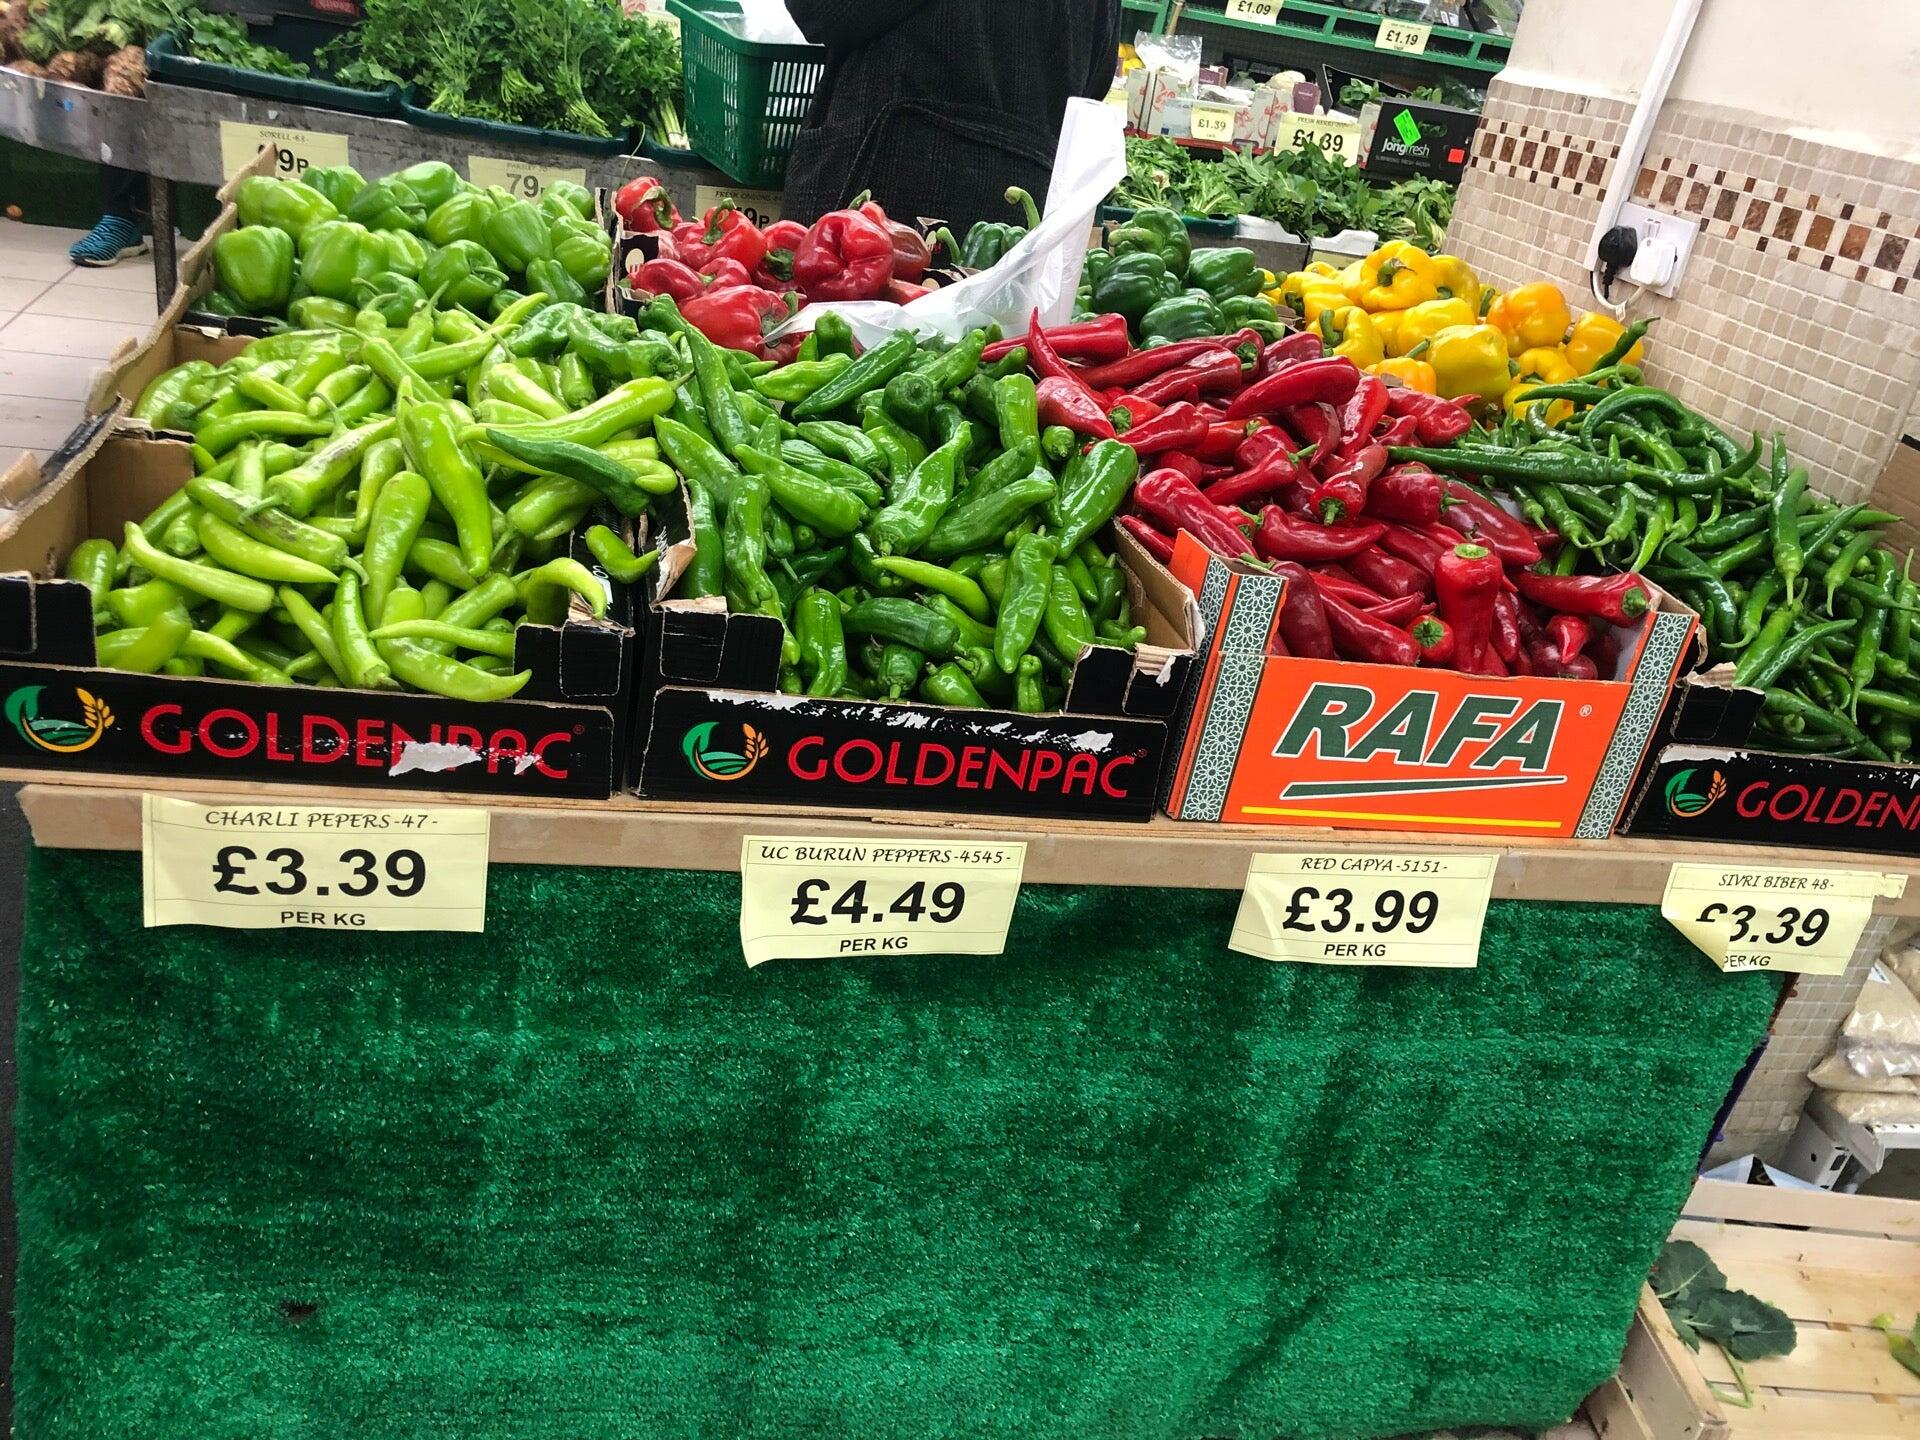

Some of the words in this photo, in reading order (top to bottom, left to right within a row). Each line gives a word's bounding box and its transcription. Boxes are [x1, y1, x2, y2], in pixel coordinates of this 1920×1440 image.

[1237, 0, 1271, 15] £1.09
[1385, 30, 1418, 45] £1.19
[1292, 129, 1343, 152] £139
[506, 172, 546, 198] 79
[736, 207, 770, 229] 9P
[1272, 682, 1566, 772] RAFA
[140, 703, 572, 779] GOLDENPAC
[787, 735, 1135, 798] GOLDENPAC
[205, 811, 298, 828] CHARLI
[761, 845, 789, 860] UC
[795, 846, 866, 861] BURUN
[212, 845, 427, 898] £3.39
[1300, 857, 1336, 871] RED
[1718, 873, 1758, 888] SIVRI
[1763, 877, 1807, 890] BIBER
[790, 878, 966, 925] £4.49
[1282, 886, 1439, 934] £3.99
[280, 911, 326, 925] PER
[334, 912, 366, 926] KG
[840, 938, 877, 952] PER
[882, 936, 909, 950] KG
[1323, 944, 1358, 956] PER
[1362, 944, 1387, 957] KG
[1750, 955, 1771, 966] KG
